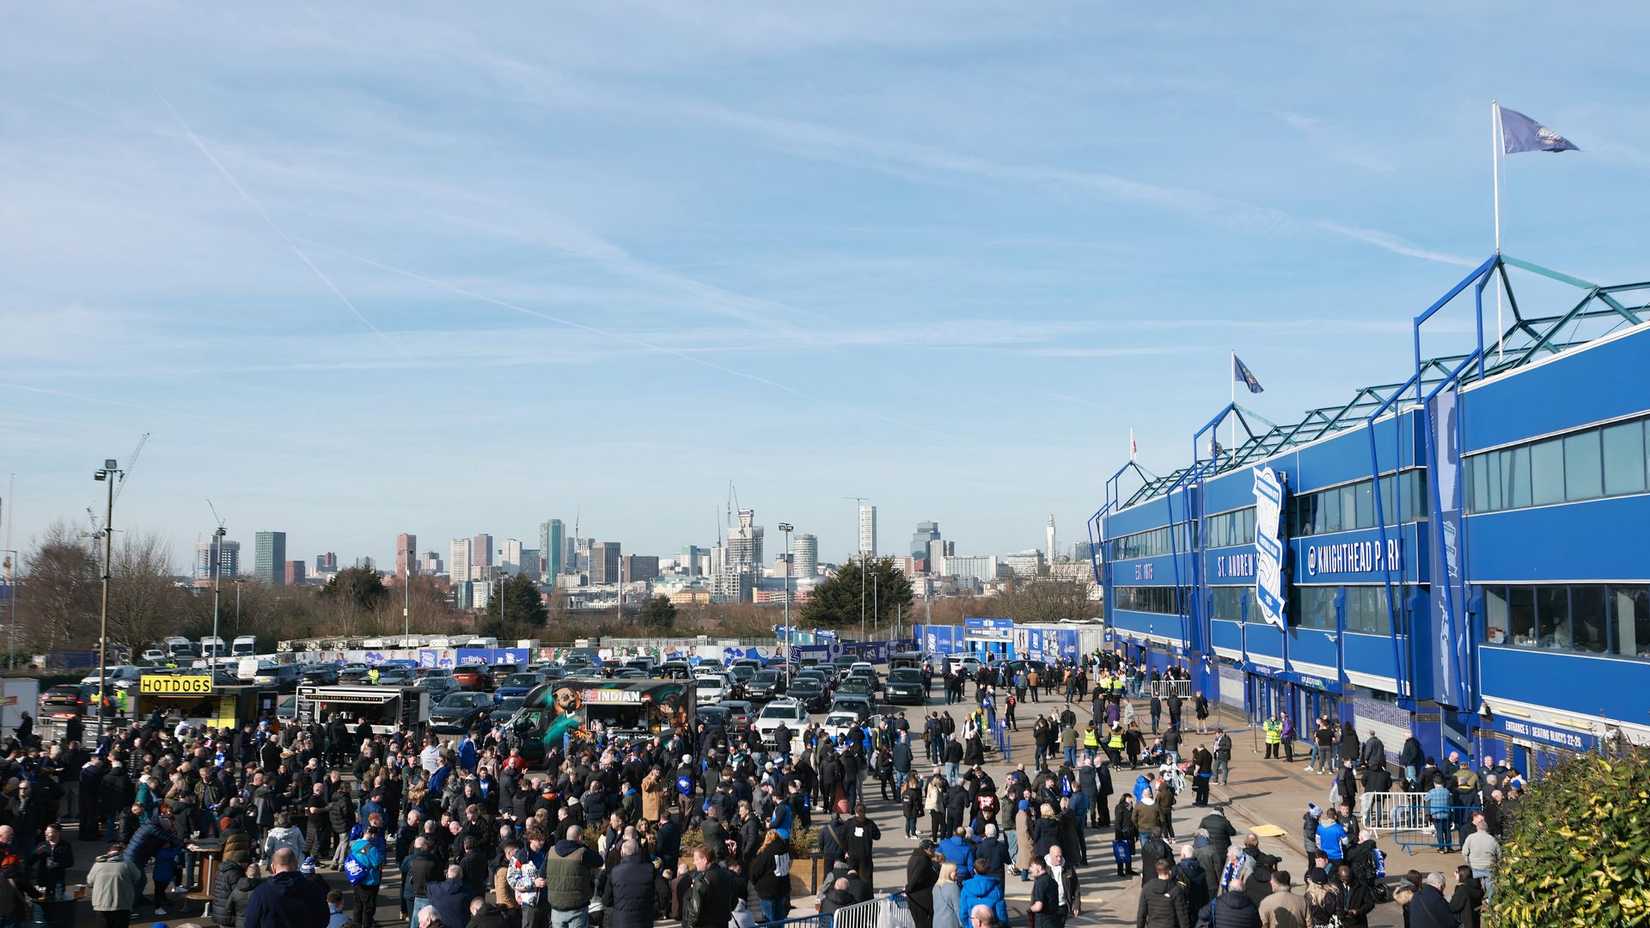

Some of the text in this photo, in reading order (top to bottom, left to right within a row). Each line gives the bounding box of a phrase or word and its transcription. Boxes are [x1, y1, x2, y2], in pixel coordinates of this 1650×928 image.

[1317, 541, 1372, 573] KNIGHTHEAD
[1374, 538, 1399, 572] PRK
[142, 679, 210, 692] HOTDOGS
[598, 690, 641, 702] INDIAN
